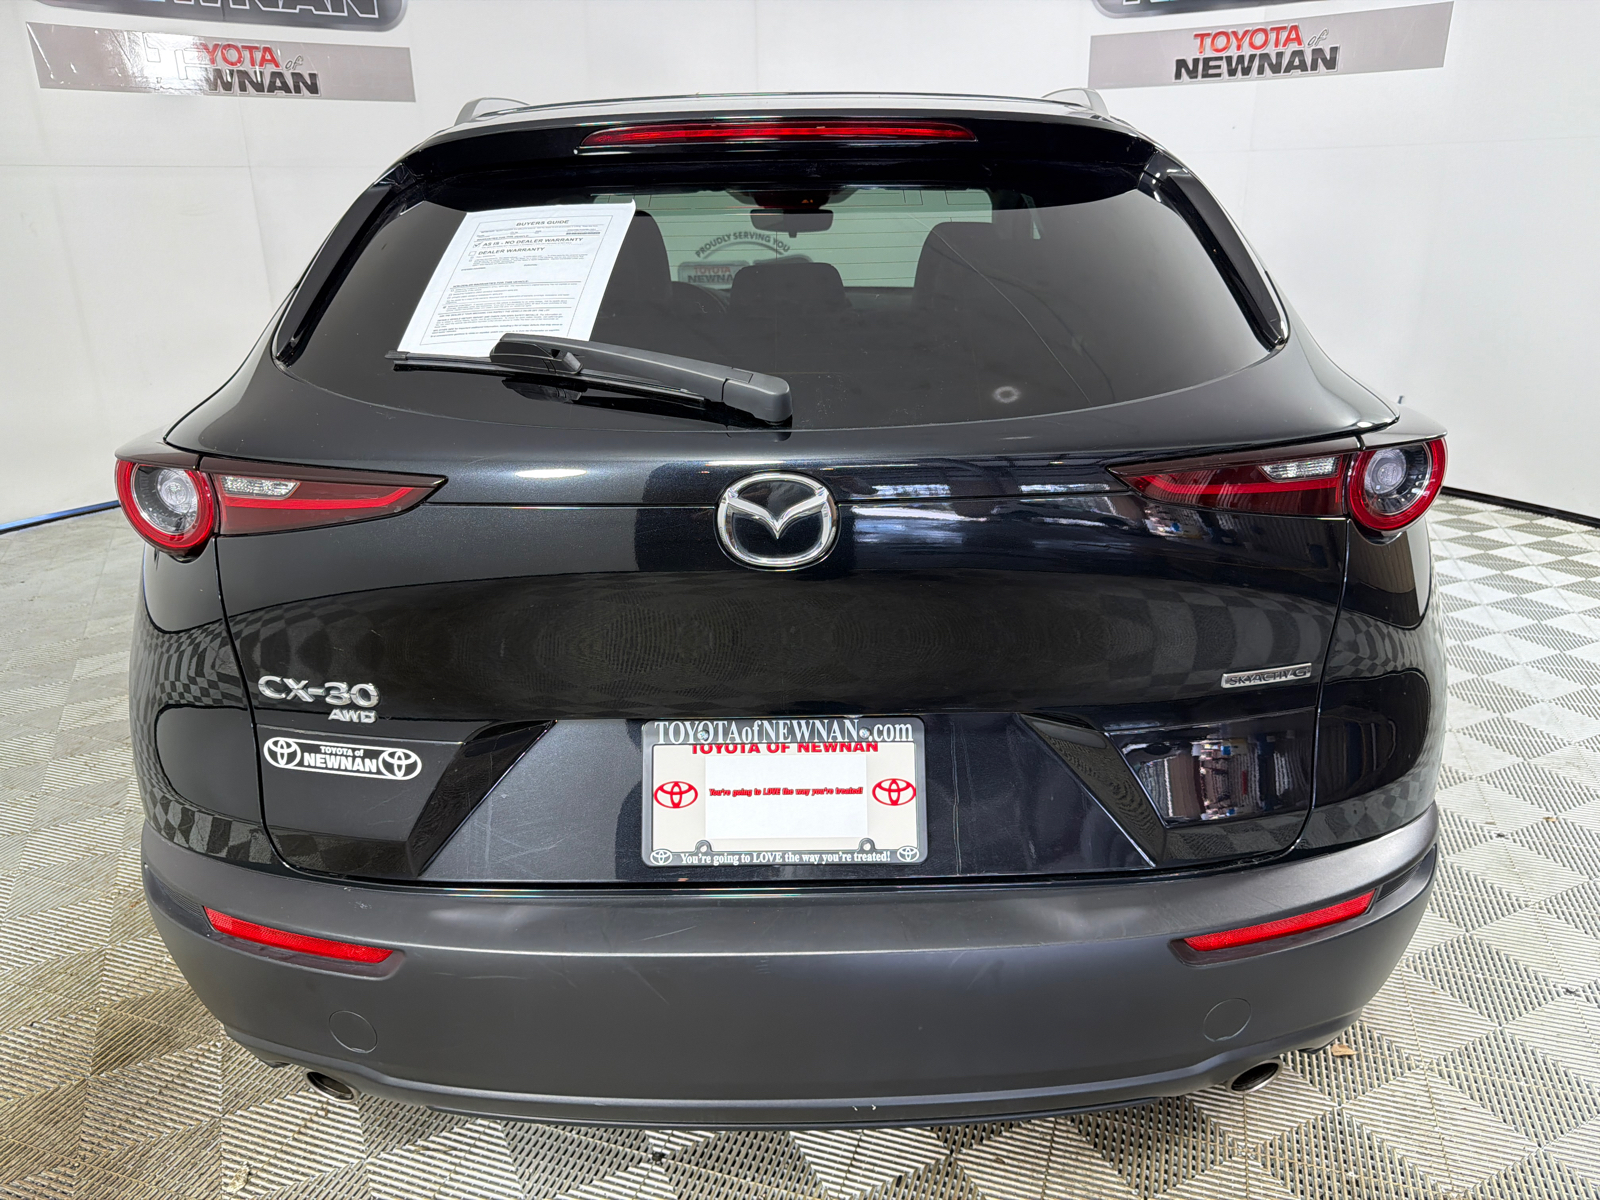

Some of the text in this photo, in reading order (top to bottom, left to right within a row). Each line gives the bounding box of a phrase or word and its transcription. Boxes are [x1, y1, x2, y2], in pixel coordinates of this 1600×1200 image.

[1193, 25, 1329, 54] TOYOTA of
[193, 43, 304, 71] YOTA of
[1174, 46, 1339, 81] NEWNAN
[206, 69, 320, 95] WNAN
[695, 231, 790, 258] PROUDLY SERVING YOU
[687, 274, 734, 284] NEWNA
[693, 266, 732, 275] TOYOTA
[258, 675, 380, 708] CX-30
[328, 708, 377, 724] AWD
[320, 745, 364, 757] TOYOTA of
[797, 742, 879, 753] NEWNAN
[303, 752, 377, 773] NEWNAN
[709, 786, 863, 797] You're going to LOVE the way you're treated!
[681, 851, 891, 866] You're going to LOVE the way you're treated!
